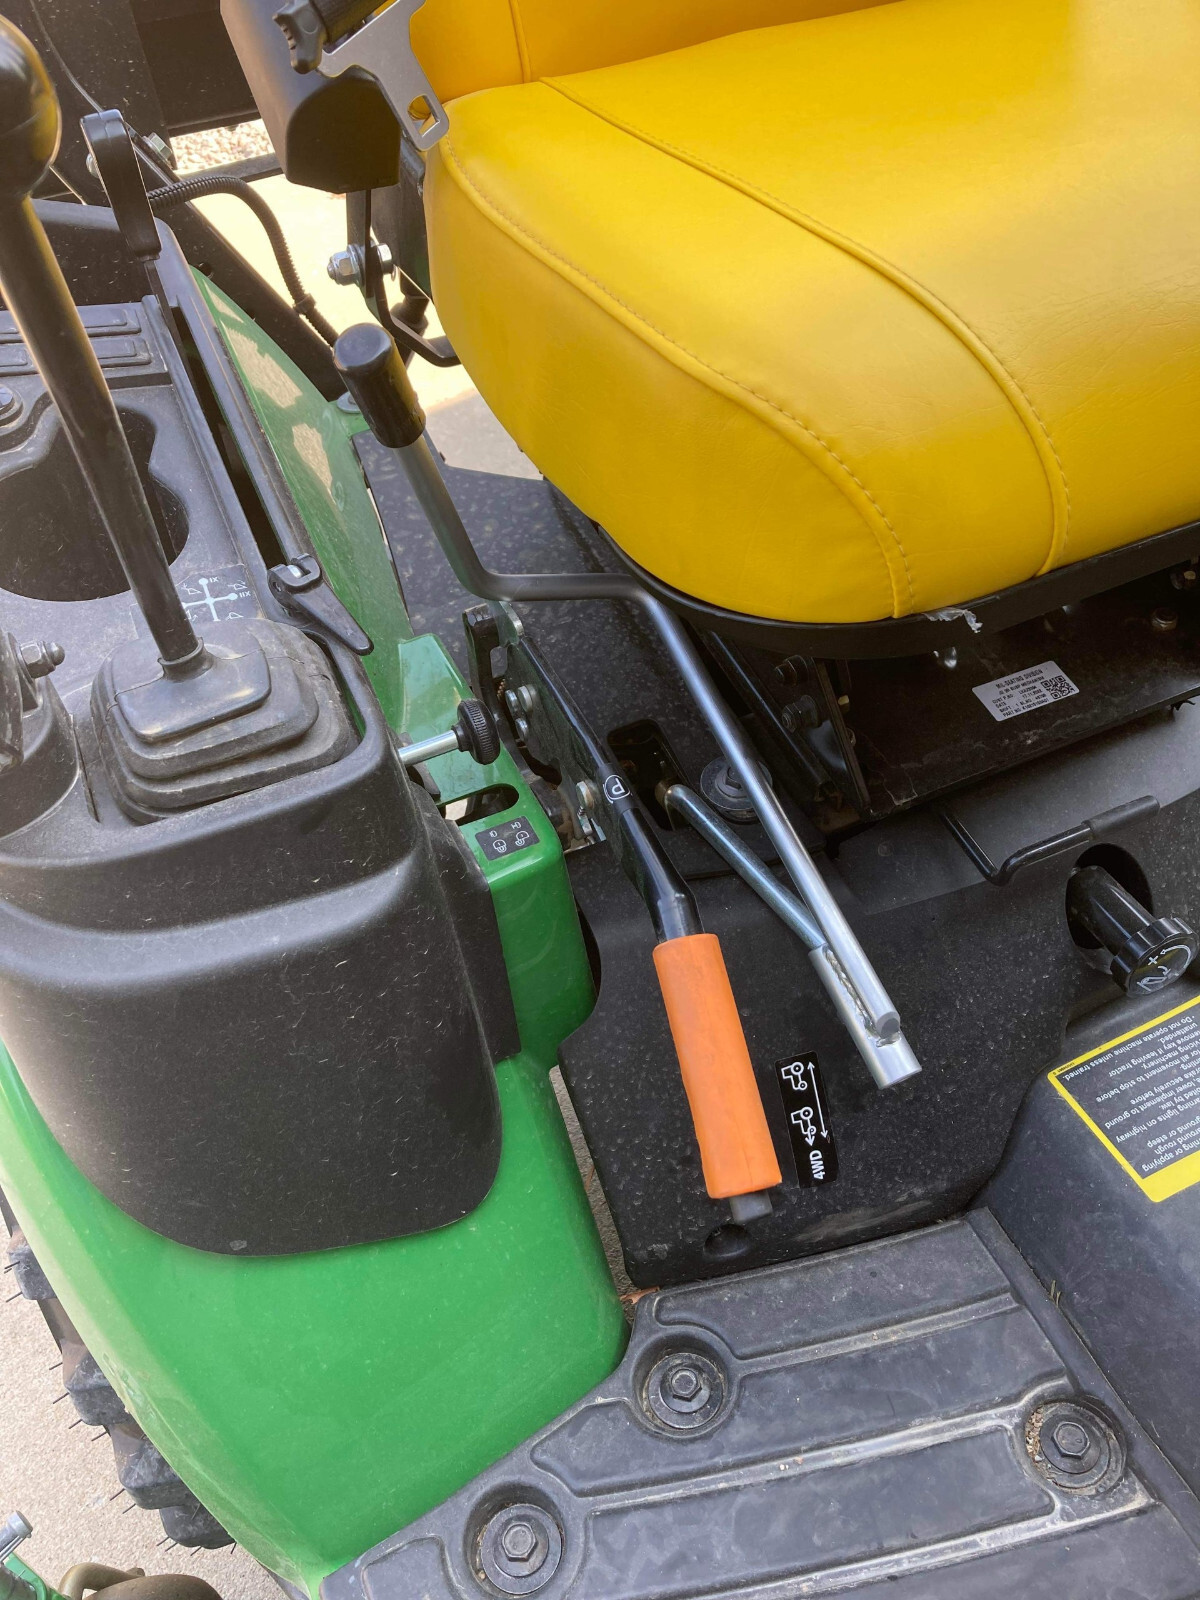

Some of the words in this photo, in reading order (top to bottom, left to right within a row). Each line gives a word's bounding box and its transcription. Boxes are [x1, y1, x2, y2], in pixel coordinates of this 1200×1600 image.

[1167, 1021, 1181, 1030] not
[1180, 1016, 1193, 1024] Do
[1142, 1027, 1168, 1041] operate
[1157, 1022, 1198, 1044] unattended.
[1113, 1038, 1143, 1055] machine
[1162, 1041, 1177, 1050] key
[1177, 1038, 1200, 1053] vicing
[1089, 1052, 1113, 1067] unless
[1130, 1050, 1158, 1065] leaving
[1140, 1050, 1179, 1069] machinery.
[1179, 1054, 1190, 1062] all
[1062, 1064, 1091, 1081] trained.
[1108, 1062, 1133, 1077] tractor
[1143, 1058, 1181, 1079] movement
[1119, 1079, 1136, 1090] stop
[1153, 1076, 1183, 1093] securely
[1175, 1080, 1196, 1093] lower
[1095, 1088, 1121, 1102] before
[1129, 1090, 1155, 1104] before
[1138, 1089, 1176, 1111] implement
[1173, 1095, 1185, 1104] by
[1158, 1100, 1175, 1110] law.
[1104, 1110, 1130, 1129] ground
[1157, 1108, 1180, 1121] lights
[1146, 1119, 1157, 1127] on
[1115, 1124, 1148, 1143] highway
[1146, 1134, 1168, 1148] steep
[1154, 1140, 1177, 1154] rough
[1181, 1137, 1200, 1151] ning
[809, 1150, 826, 1180] 4WD
[1141, 1152, 1174, 1172] applying
